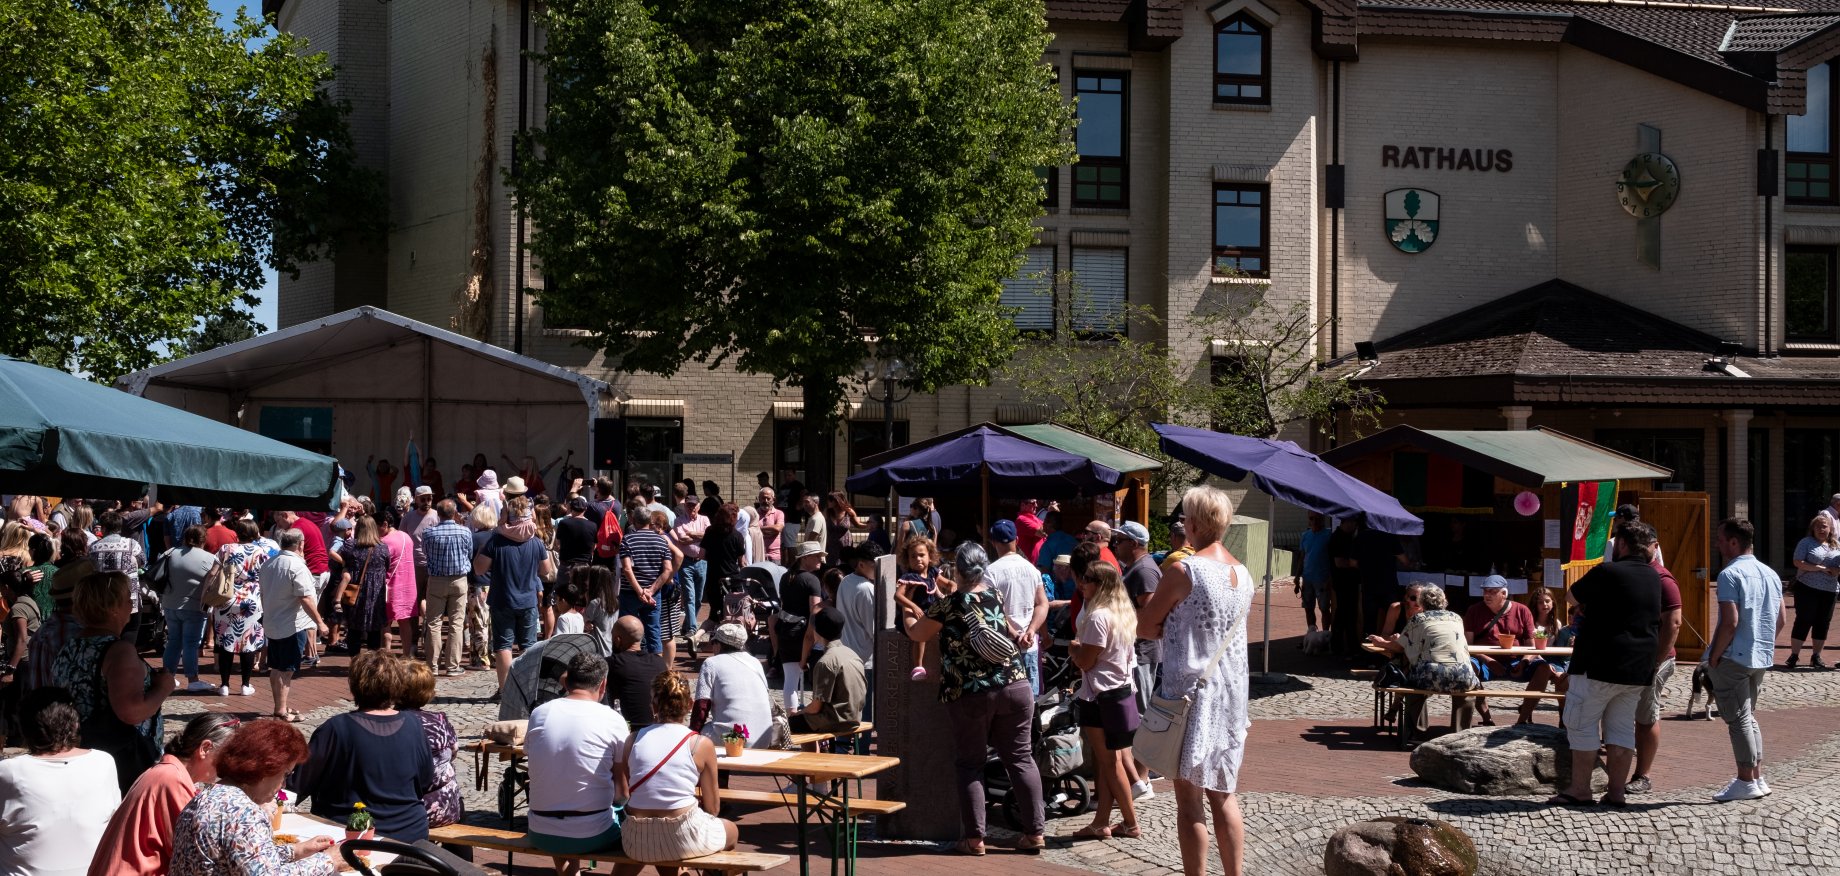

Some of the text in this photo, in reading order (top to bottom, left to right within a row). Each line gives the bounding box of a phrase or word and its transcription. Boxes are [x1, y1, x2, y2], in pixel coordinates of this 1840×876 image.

[1382, 144, 1513, 173] RATHAUS
[1643, 154, 1652, 162] 12
[1666, 164, 1673, 174] 2
[1670, 177, 1677, 187] 3
[1617, 183, 1624, 193] 9
[1622, 197, 1629, 206] 8
[1631, 205, 1637, 214] 7
[1643, 207, 1650, 217] 6
[887, 640, 899, 680] PLATZ
